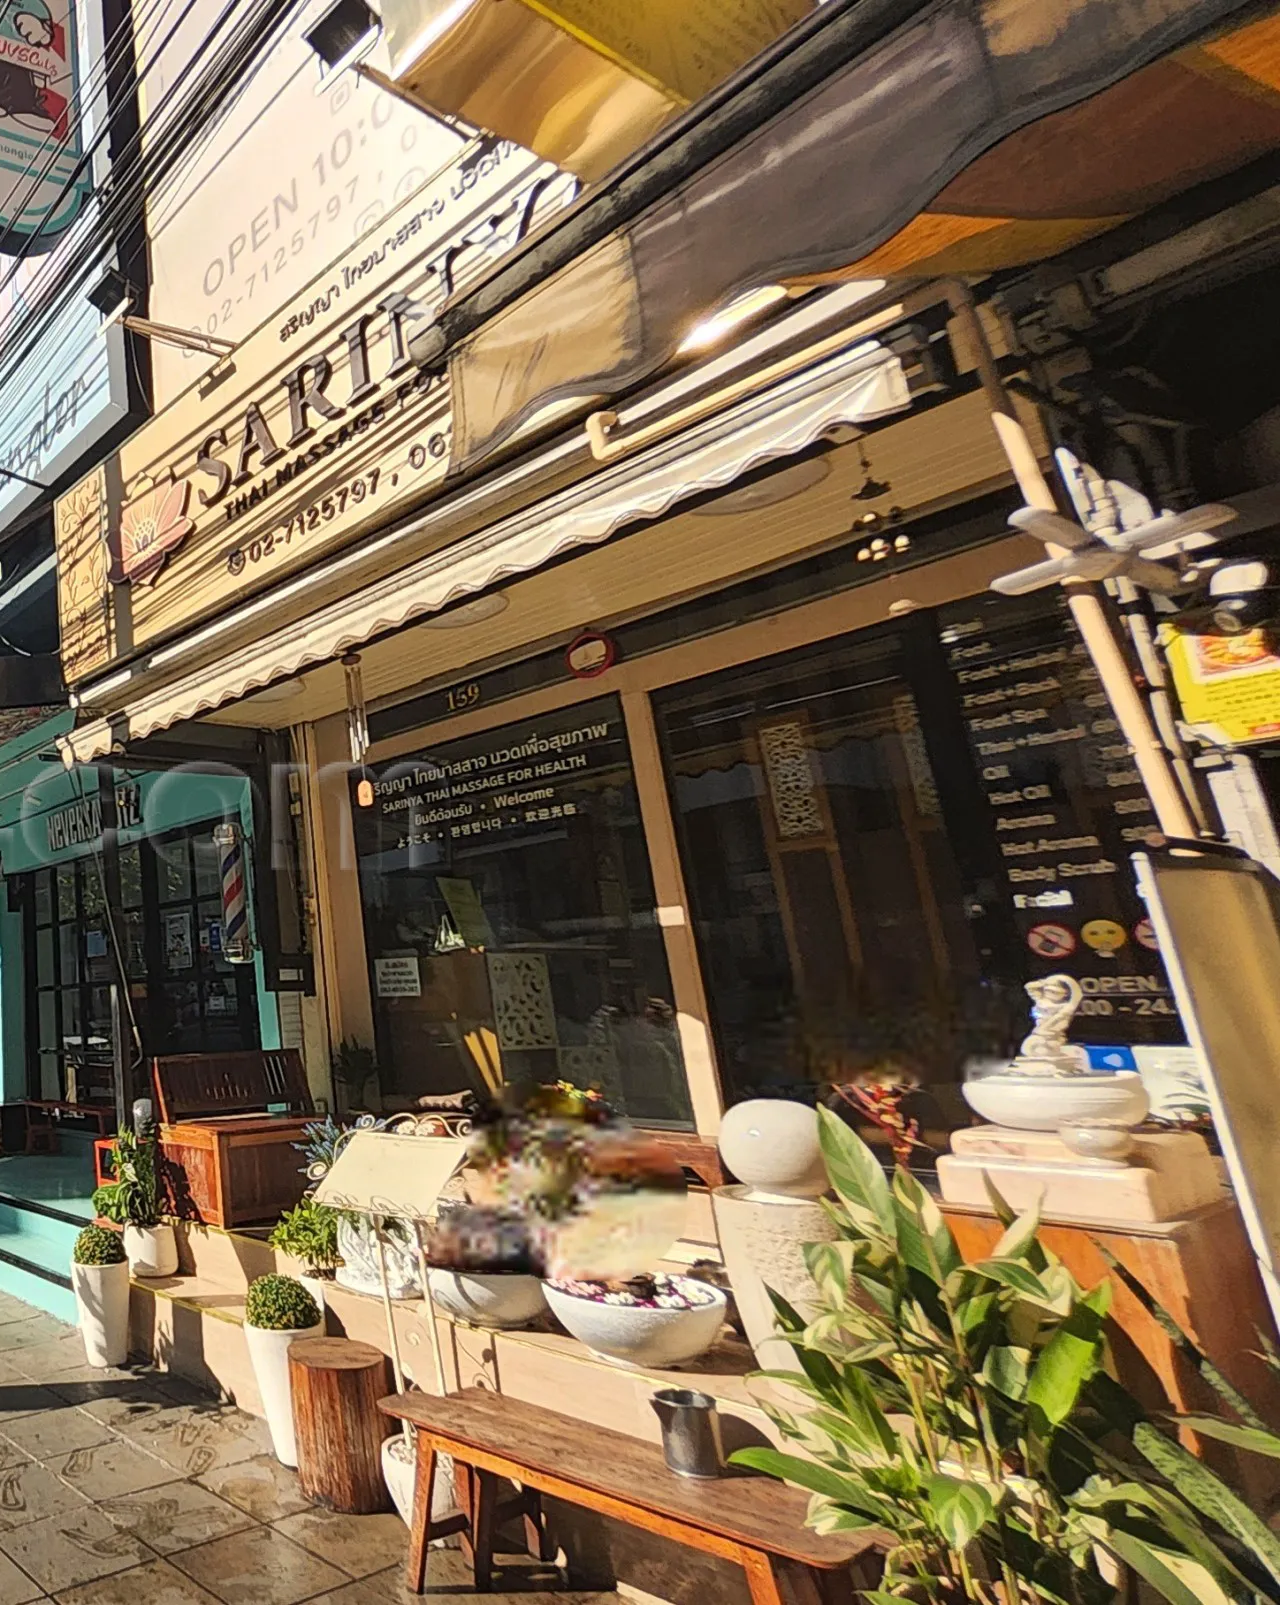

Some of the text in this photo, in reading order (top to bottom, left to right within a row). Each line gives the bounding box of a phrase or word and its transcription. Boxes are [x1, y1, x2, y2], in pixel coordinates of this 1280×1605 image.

[202, 92, 395, 297] OPEN 10:0
[223, 478, 270, 521] THAI
[274, 400, 386, 488] MASSAGE
[446, 683, 480, 712] 159
[370, 774, 412, 800] ริญญา
[382, 754, 587, 814] SARINYA THAI MASSAGE FOR HEALTH
[493, 787, 555, 809] Welcome
